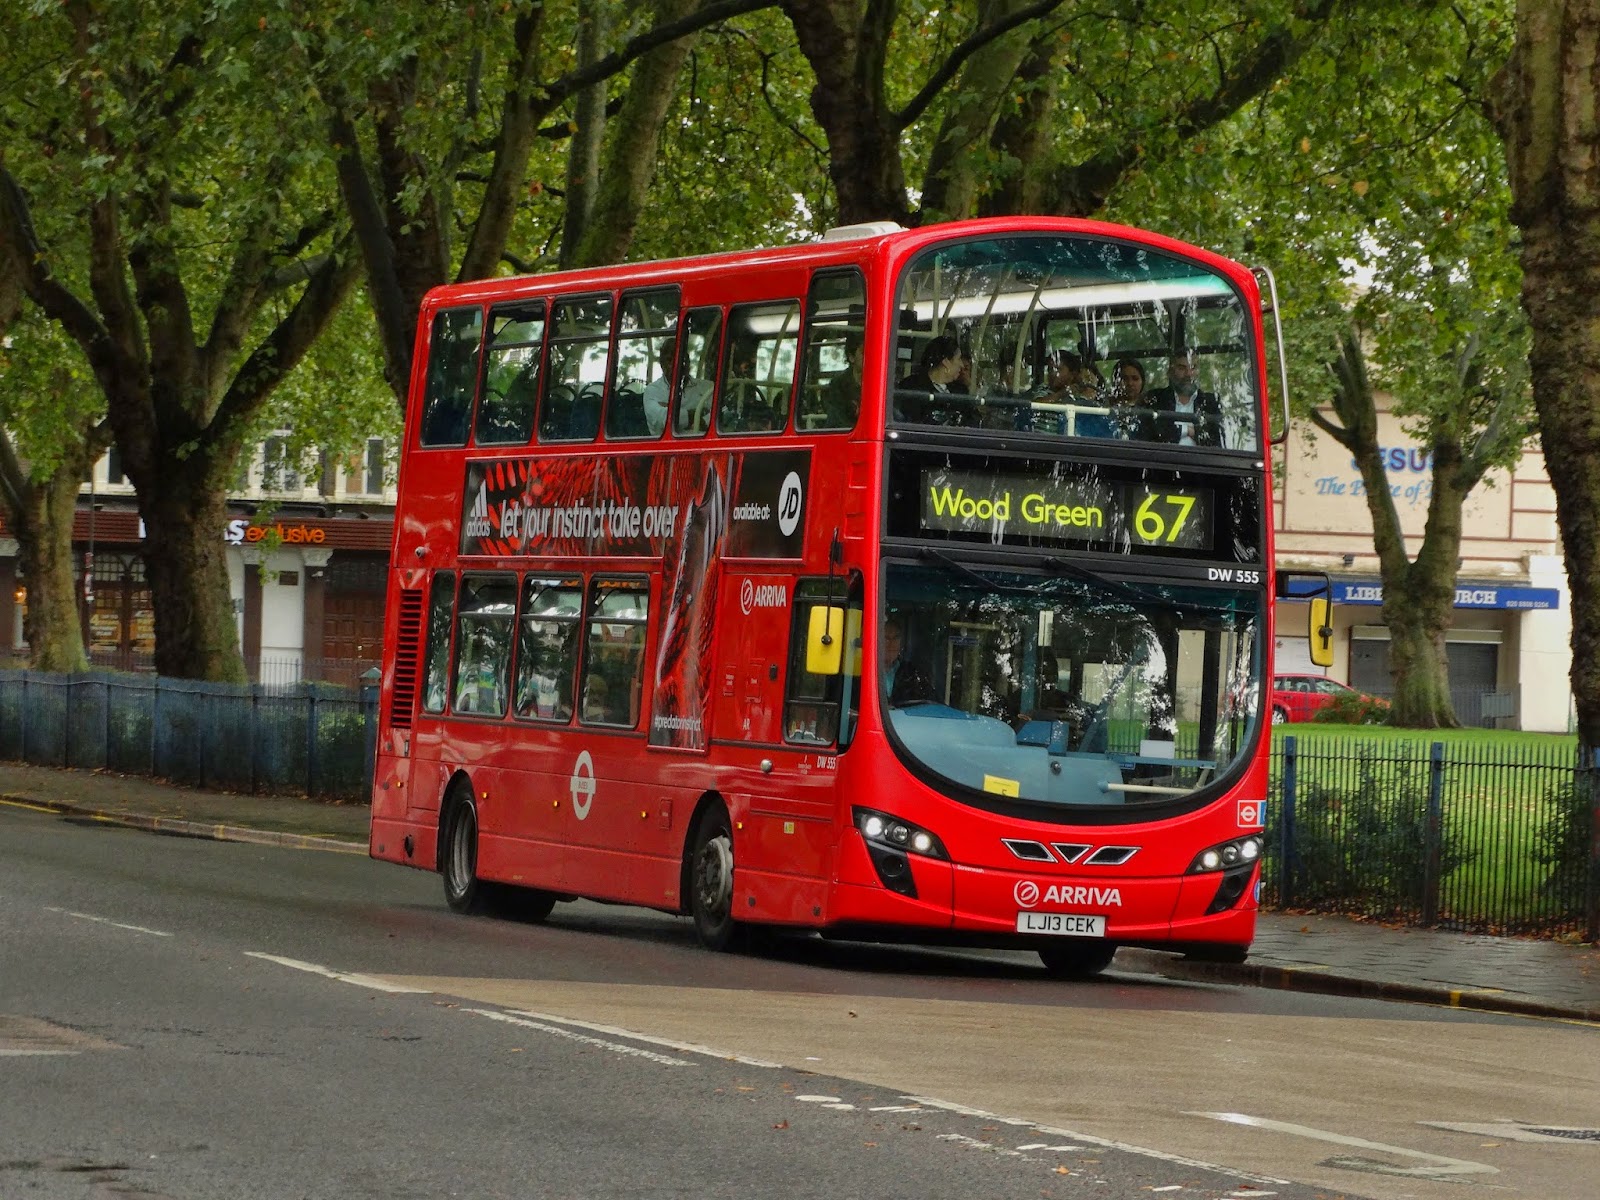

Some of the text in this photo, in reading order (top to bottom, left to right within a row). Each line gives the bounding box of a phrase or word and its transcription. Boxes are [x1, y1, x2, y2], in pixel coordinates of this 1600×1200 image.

[1315, 476, 1346, 496] The
[1405, 479, 1425, 505] of
[733, 502, 762, 521] available
[781, 487, 799, 520] JD
[930, 487, 1103, 529] Wood Green
[466, 516, 491, 537] adidas
[501, 496, 679, 546] let your instinct take over
[1135, 492, 1197, 543] 67
[246, 523, 326, 543] exlusive
[1208, 567, 1260, 585] DW 555
[754, 585, 787, 607] ARRIVA
[817, 755, 827, 769] DW
[827, 756, 836, 770] 555
[1043, 885, 1123, 907] ARRIVA
[1026, 914, 1096, 933] LJ13 CEK
